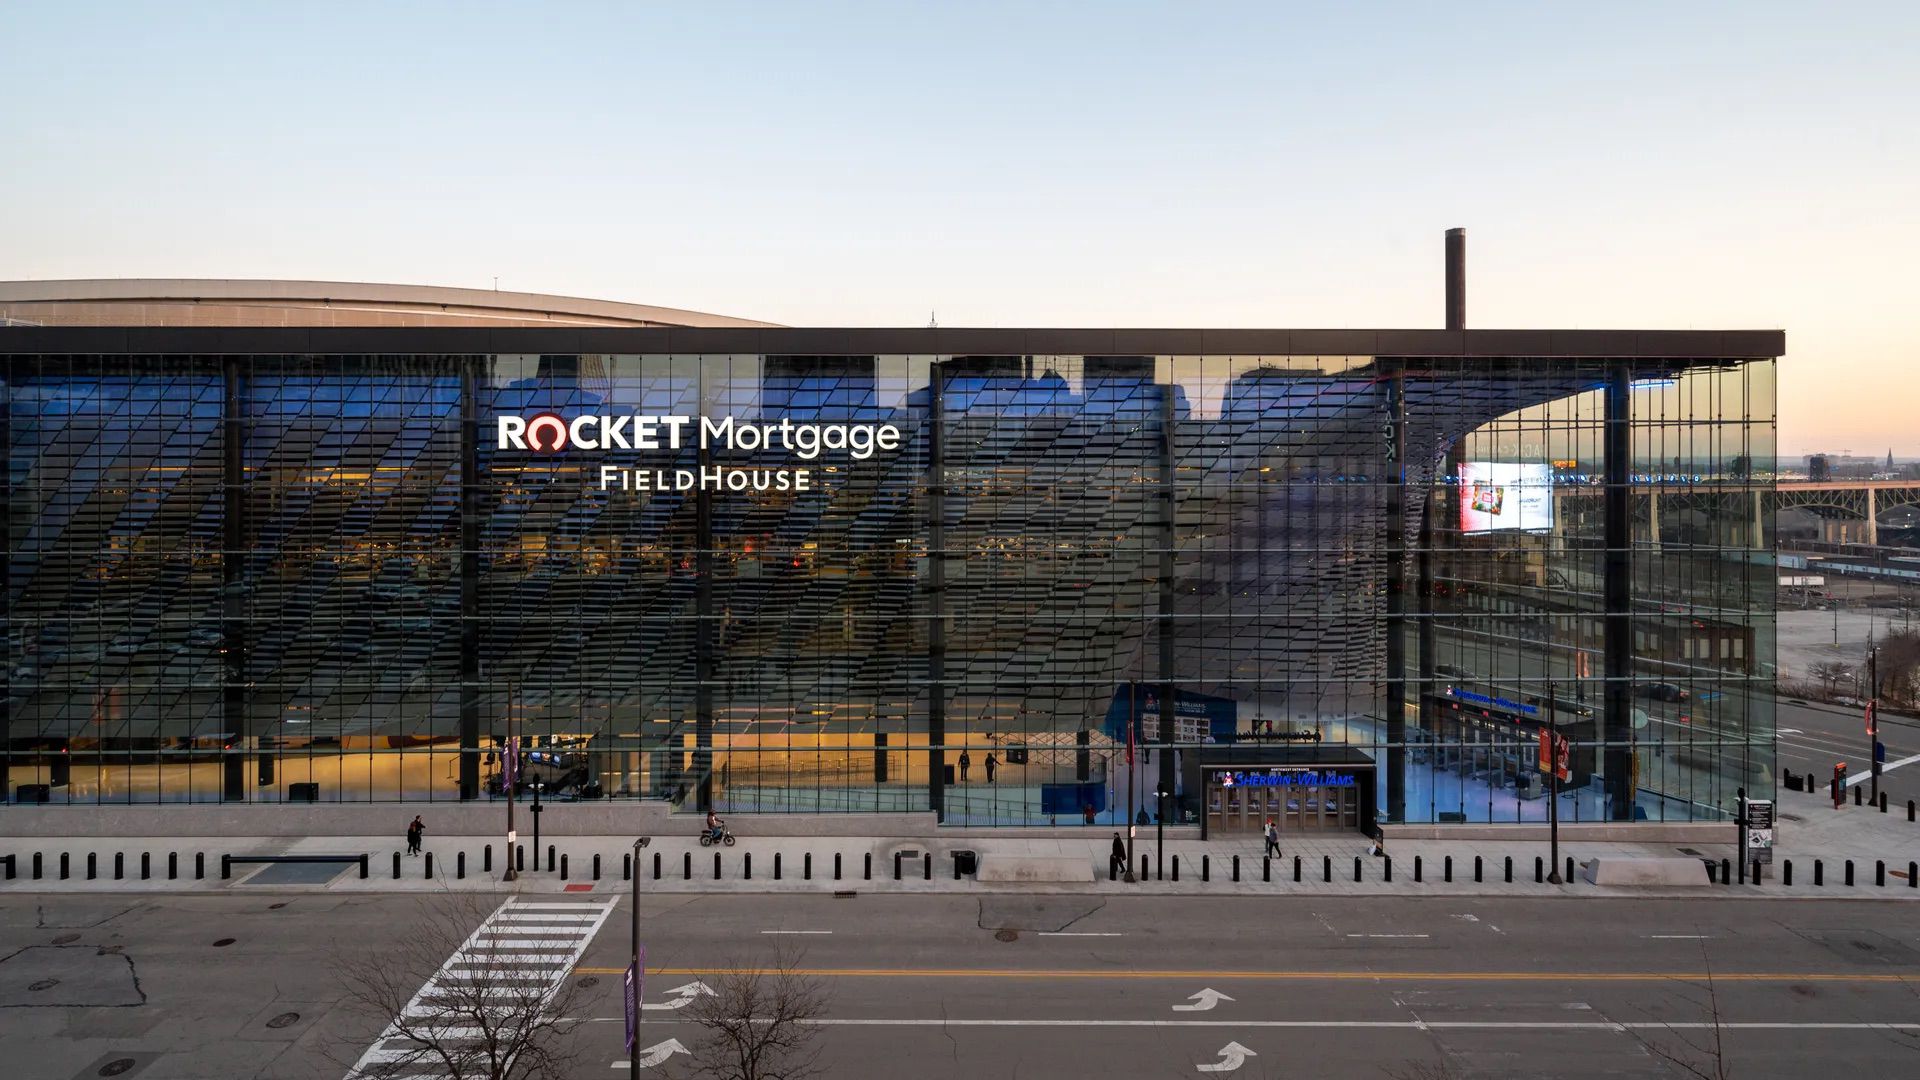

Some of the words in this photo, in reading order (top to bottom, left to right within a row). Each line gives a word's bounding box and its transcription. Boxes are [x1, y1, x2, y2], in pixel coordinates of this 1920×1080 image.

[498, 412, 690, 454] ROCKET
[700, 416, 900, 460] Mortgage
[1234, 772, 1355, 786] SHERWIN-WILLIAMS
